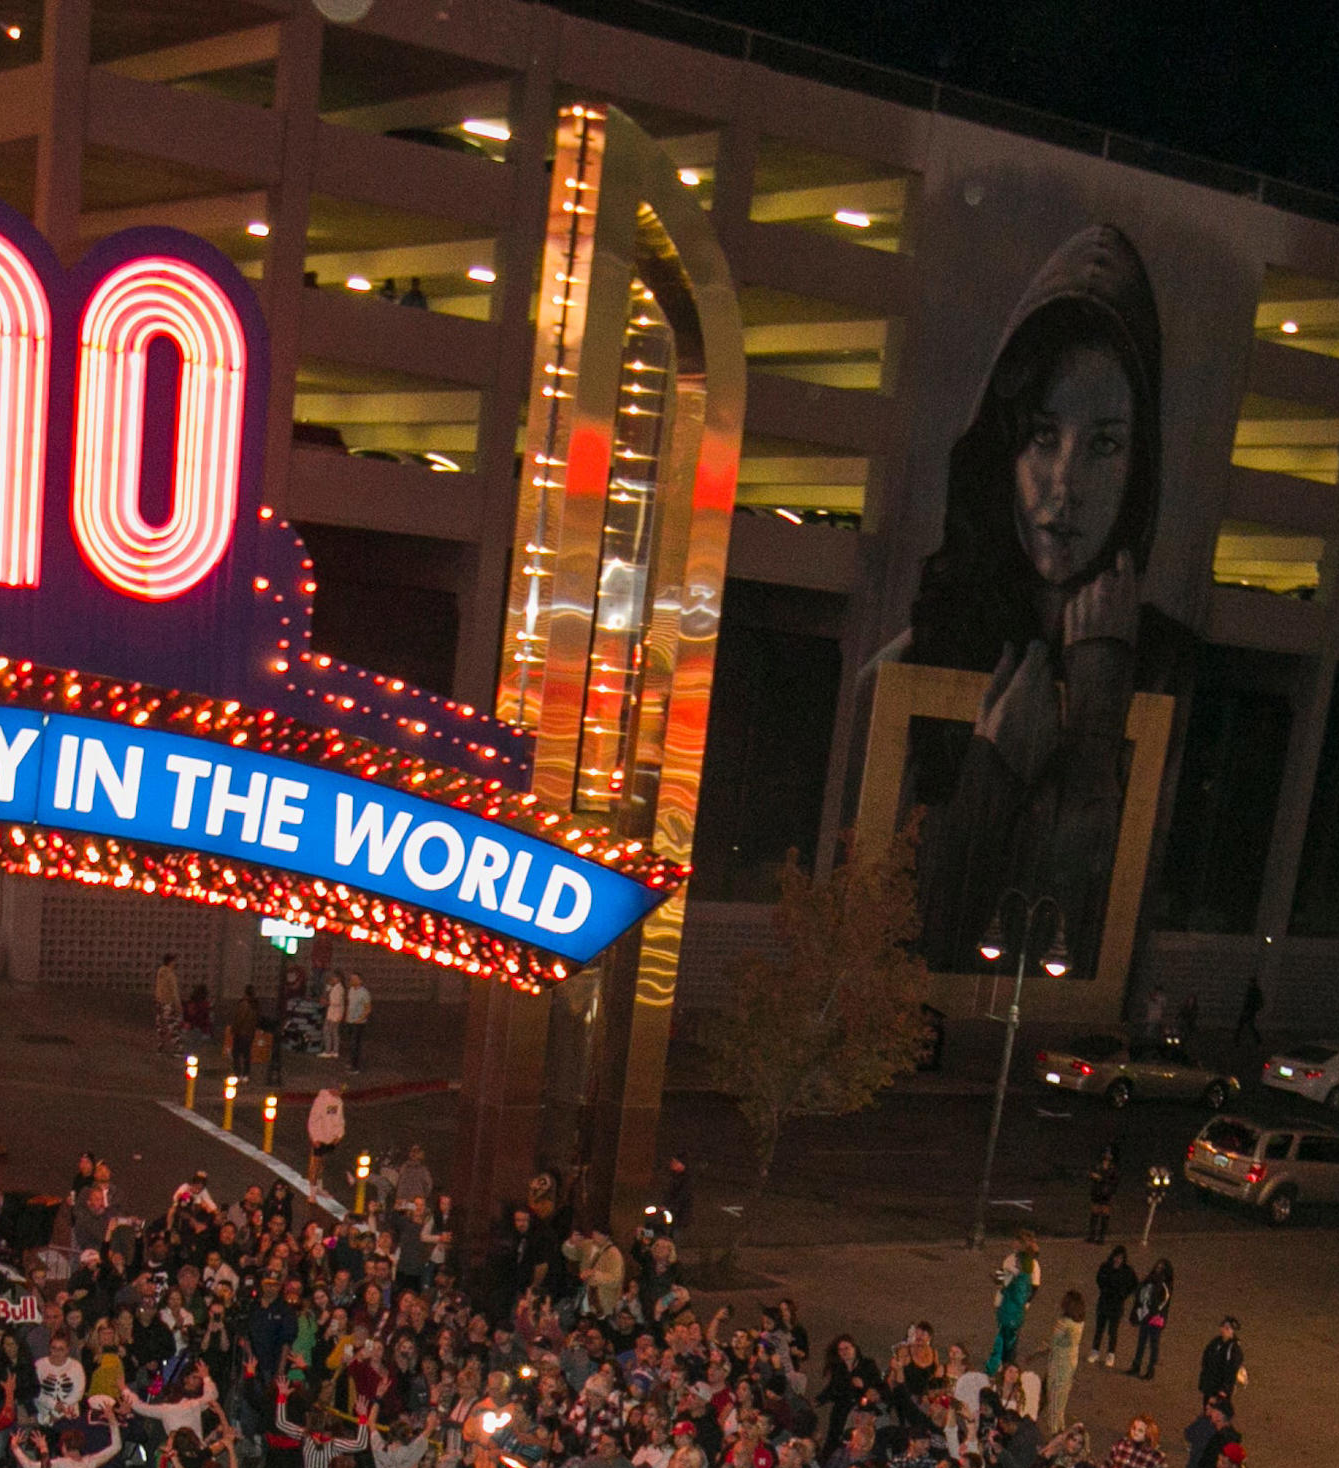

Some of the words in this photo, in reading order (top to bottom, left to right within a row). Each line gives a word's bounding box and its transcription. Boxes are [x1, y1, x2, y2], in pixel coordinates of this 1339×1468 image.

[52, 734, 145, 821] IN
[165, 753, 310, 853] THE
[333, 786, 593, 935] WORLD
